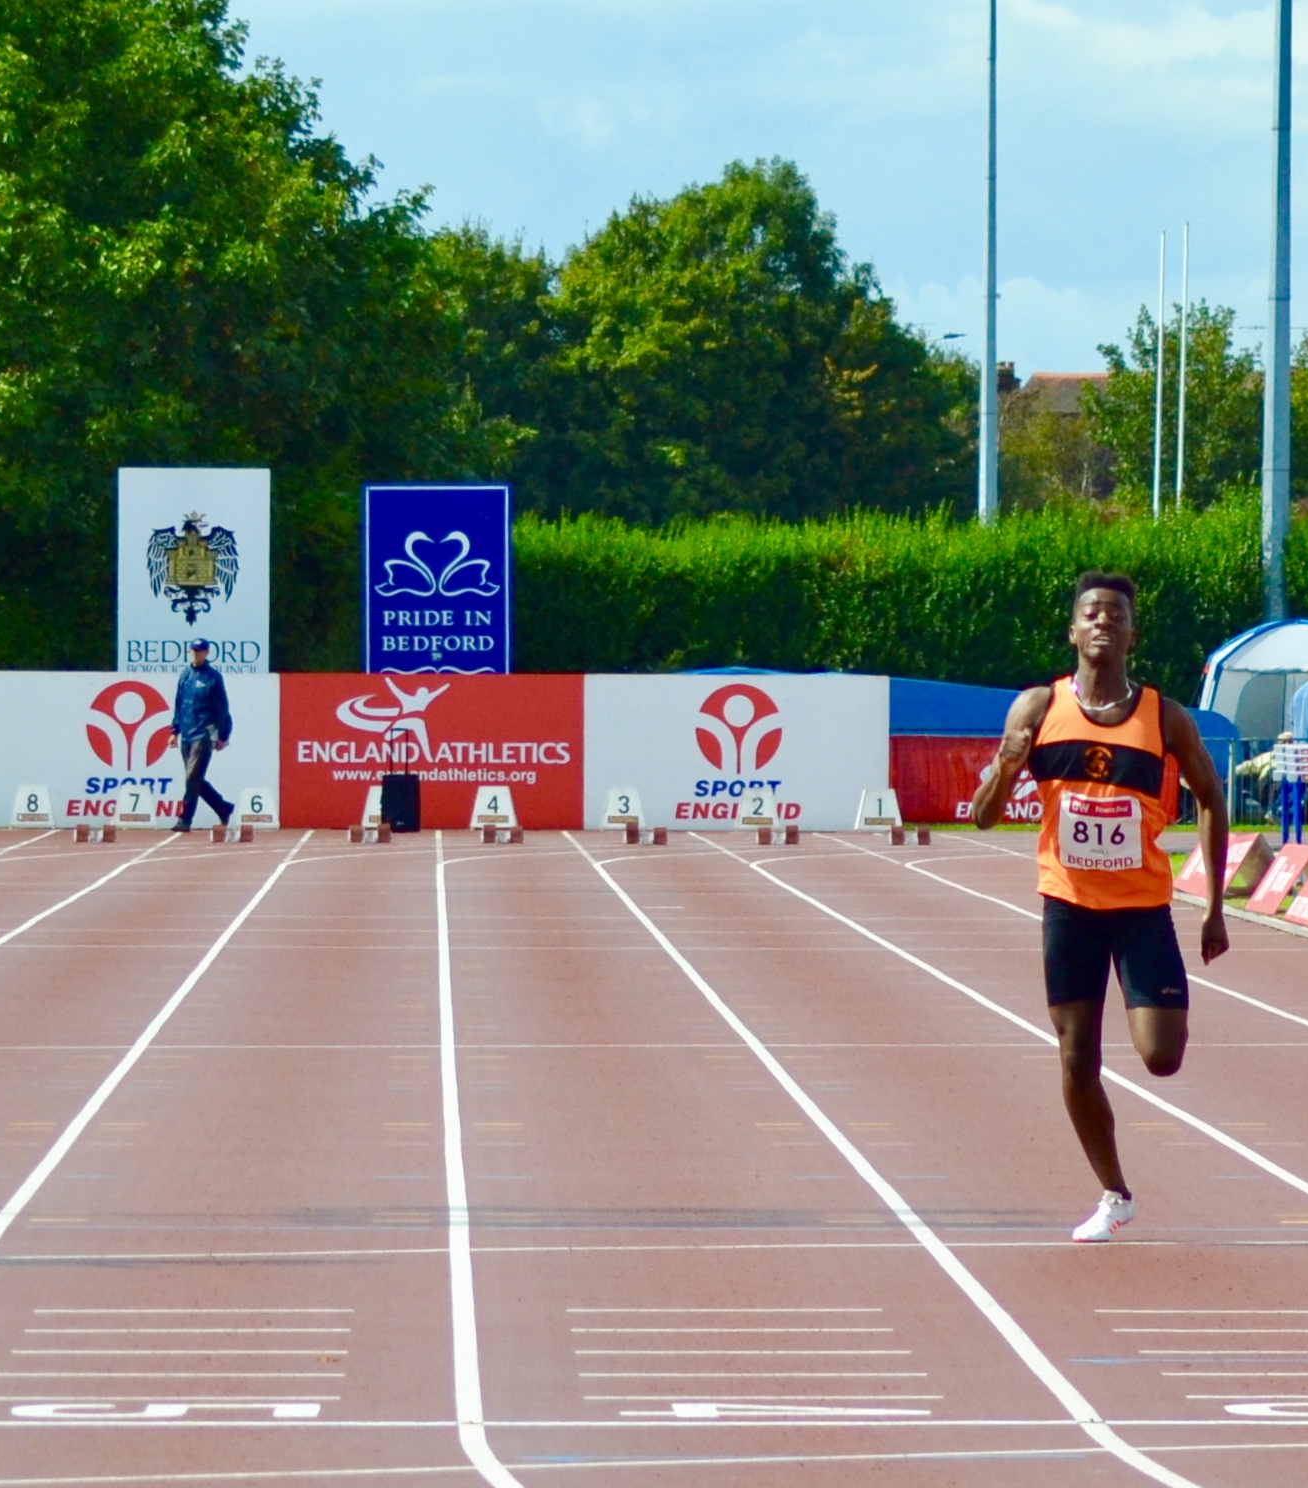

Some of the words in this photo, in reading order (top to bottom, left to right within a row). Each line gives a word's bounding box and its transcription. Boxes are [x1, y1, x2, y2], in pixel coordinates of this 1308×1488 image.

[382, 610, 454, 626] PRIDE
[464, 610, 492, 626] IN
[381, 635, 494, 651] BEDFORD
[297, 741, 421, 763] ENGLAND
[431, 742, 571, 765] ATHLETICS
[332, 767, 537, 784] www.endathletics.org
[27, 793, 39, 813] 8
[66, 799, 184, 819] ENGN
[129, 793, 140, 812] 7
[251, 795, 263, 813] 6
[487, 795, 499, 814] 4
[618, 795, 630, 814] 3
[675, 802, 802, 819] ENGLD
[752, 797, 764, 815] 2
[877, 798, 883, 817] 1
[956, 801, 1042, 819] ENAND
[1072, 820, 1126, 846] 816
[1067, 855, 1134, 869] BEDFORD
